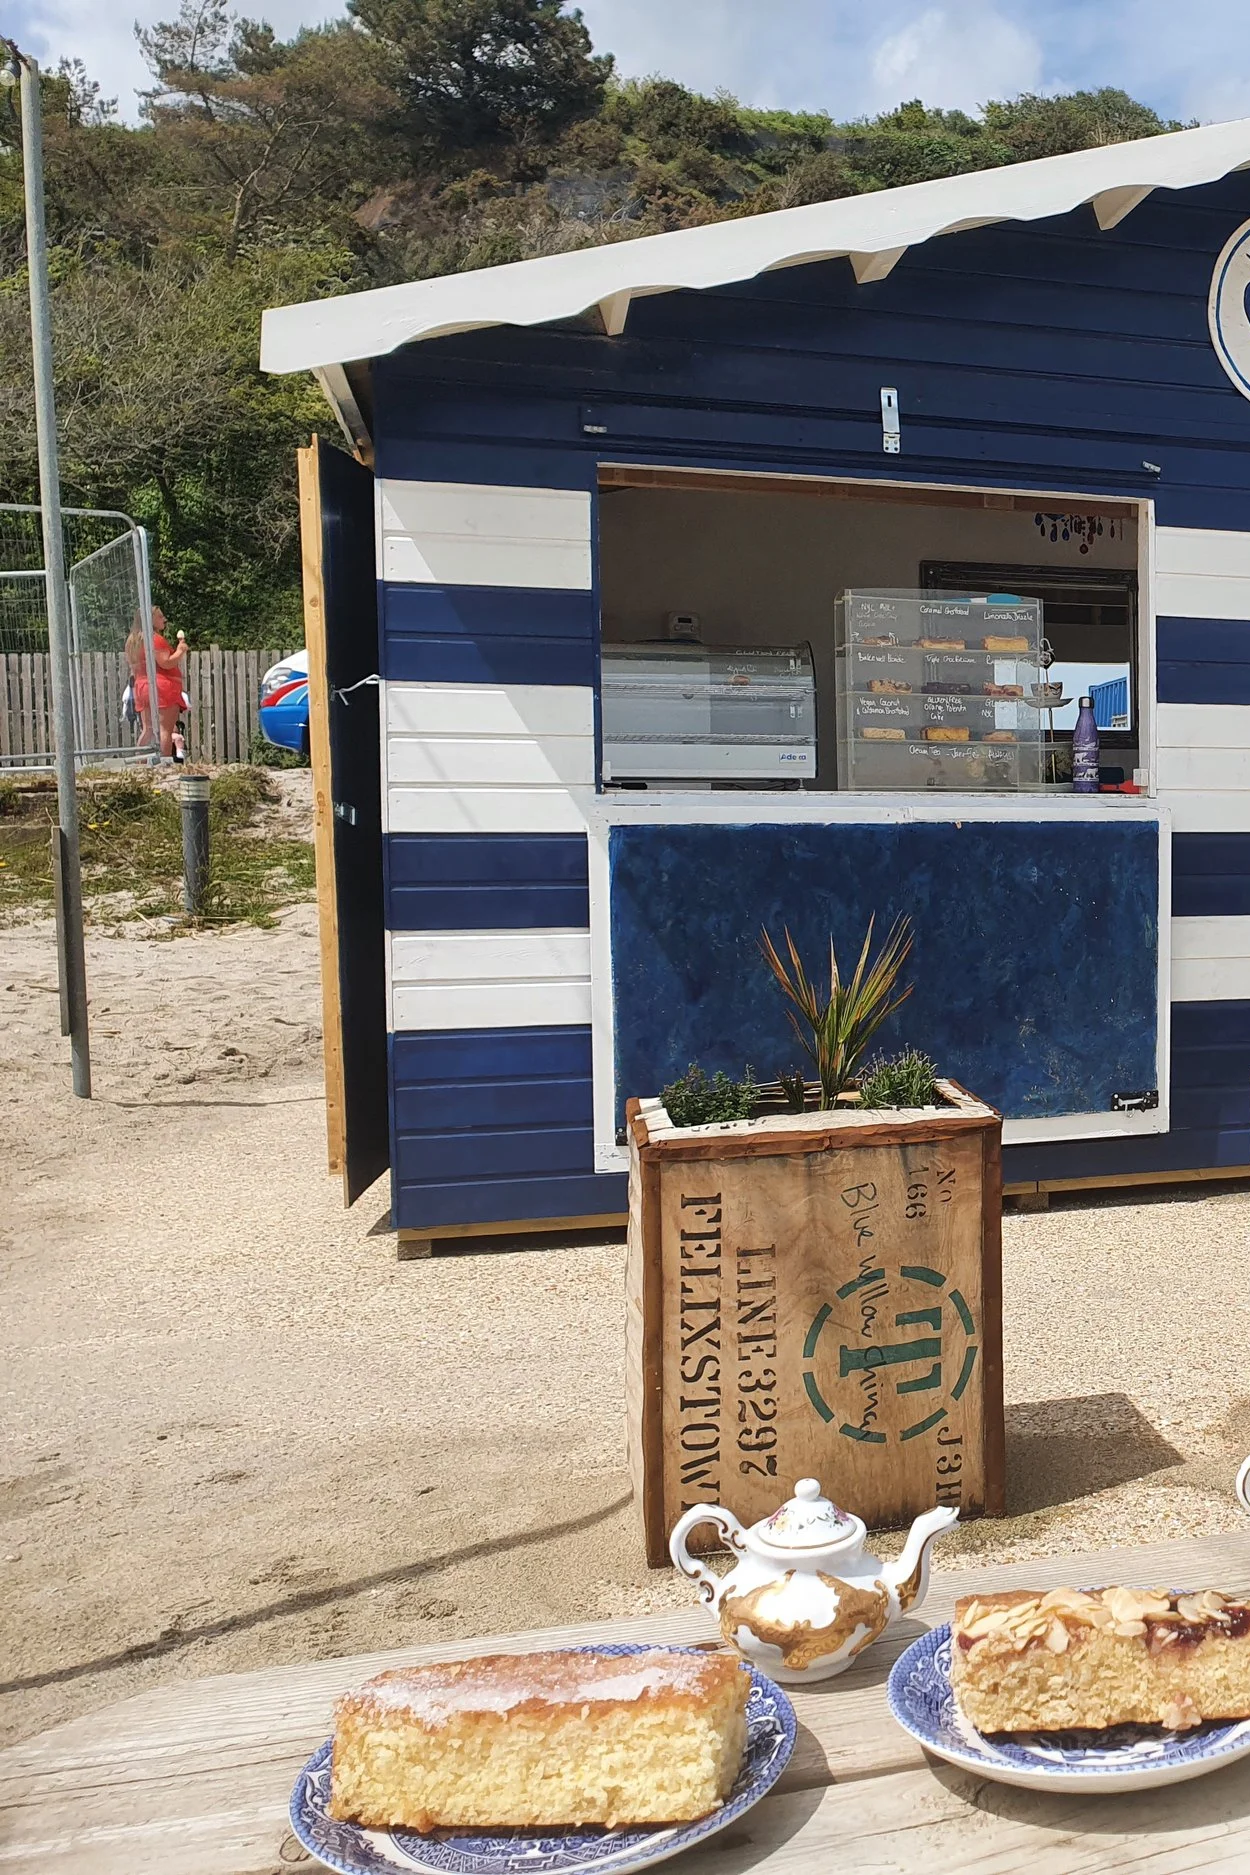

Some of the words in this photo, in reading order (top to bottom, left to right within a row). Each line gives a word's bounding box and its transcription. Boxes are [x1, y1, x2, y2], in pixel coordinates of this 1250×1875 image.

[841, 1182, 881, 1247] Blue
[905, 1164, 929, 1220] 166
[736, 1243, 777, 1361] LINE
[737, 1368, 778, 1477] 3297
